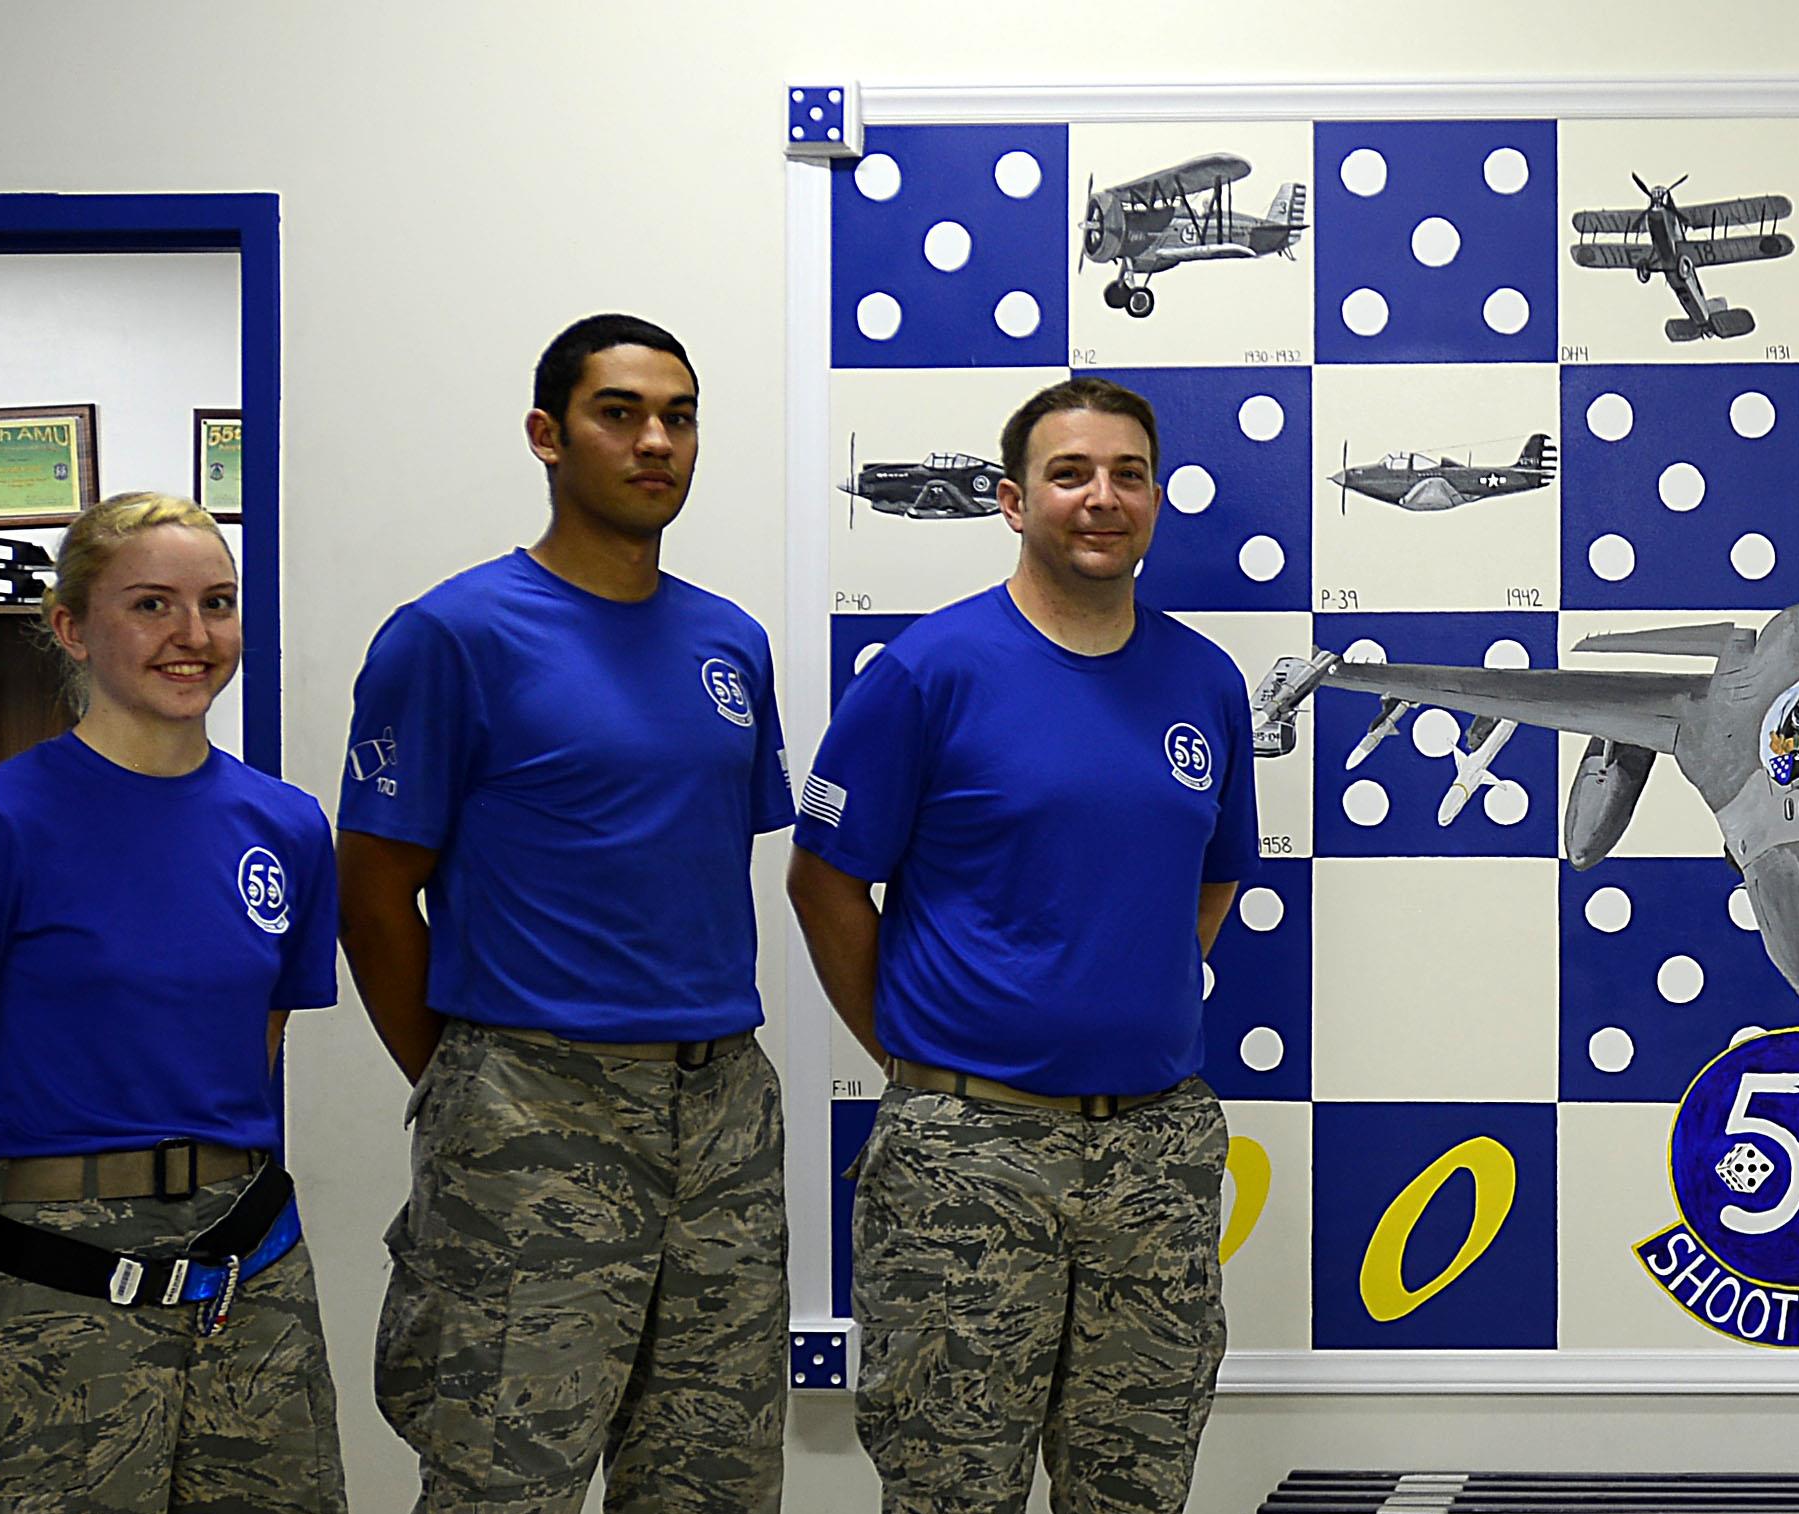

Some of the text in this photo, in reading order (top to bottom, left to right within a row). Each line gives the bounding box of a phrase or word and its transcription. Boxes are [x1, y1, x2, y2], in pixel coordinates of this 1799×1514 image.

[1072, 350, 1097, 365] P-12
[1561, 346, 1791, 361] DH4 1931
[17, 424, 69, 446] AMU
[835, 591, 872, 611] P-40
[1321, 588, 1543, 609] P-39 1942
[1173, 735, 1206, 771] 55
[247, 863, 281, 909] 55
